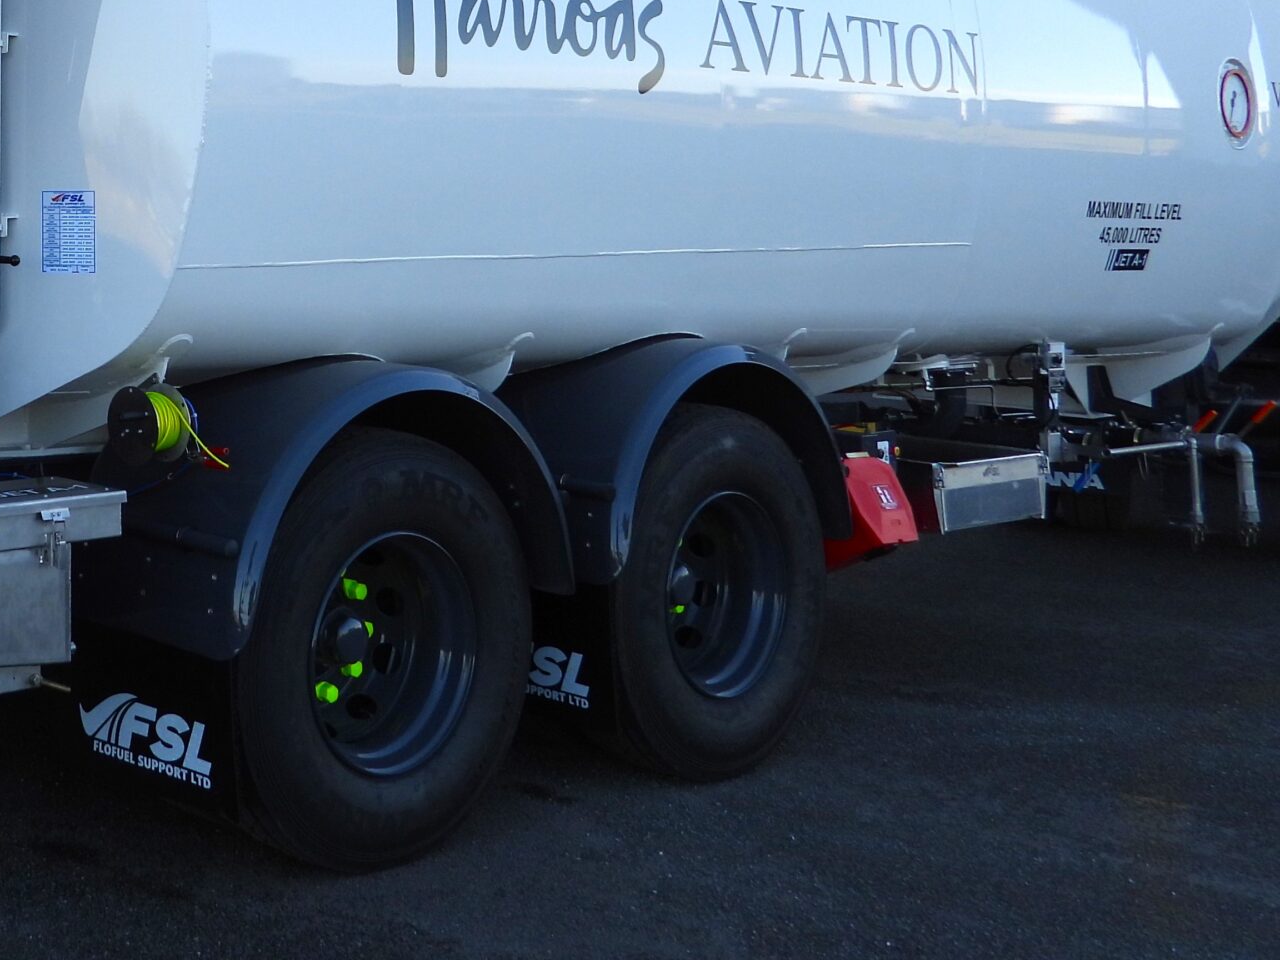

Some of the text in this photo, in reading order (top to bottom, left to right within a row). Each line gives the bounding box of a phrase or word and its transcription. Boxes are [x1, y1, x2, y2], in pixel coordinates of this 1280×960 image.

[1087, 201, 1182, 220] MAXIMUM FILL LEVEL
[1099, 227, 1162, 245] 45,000 LITRES
[1115, 253, 1147, 267] JET A-1
[528, 646, 590, 697] SL
[526, 684, 589, 709] PPORT LTD
[118, 702, 212, 776] FSL
[93, 740, 211, 789] FLOFUEL SUPPORT LTD
